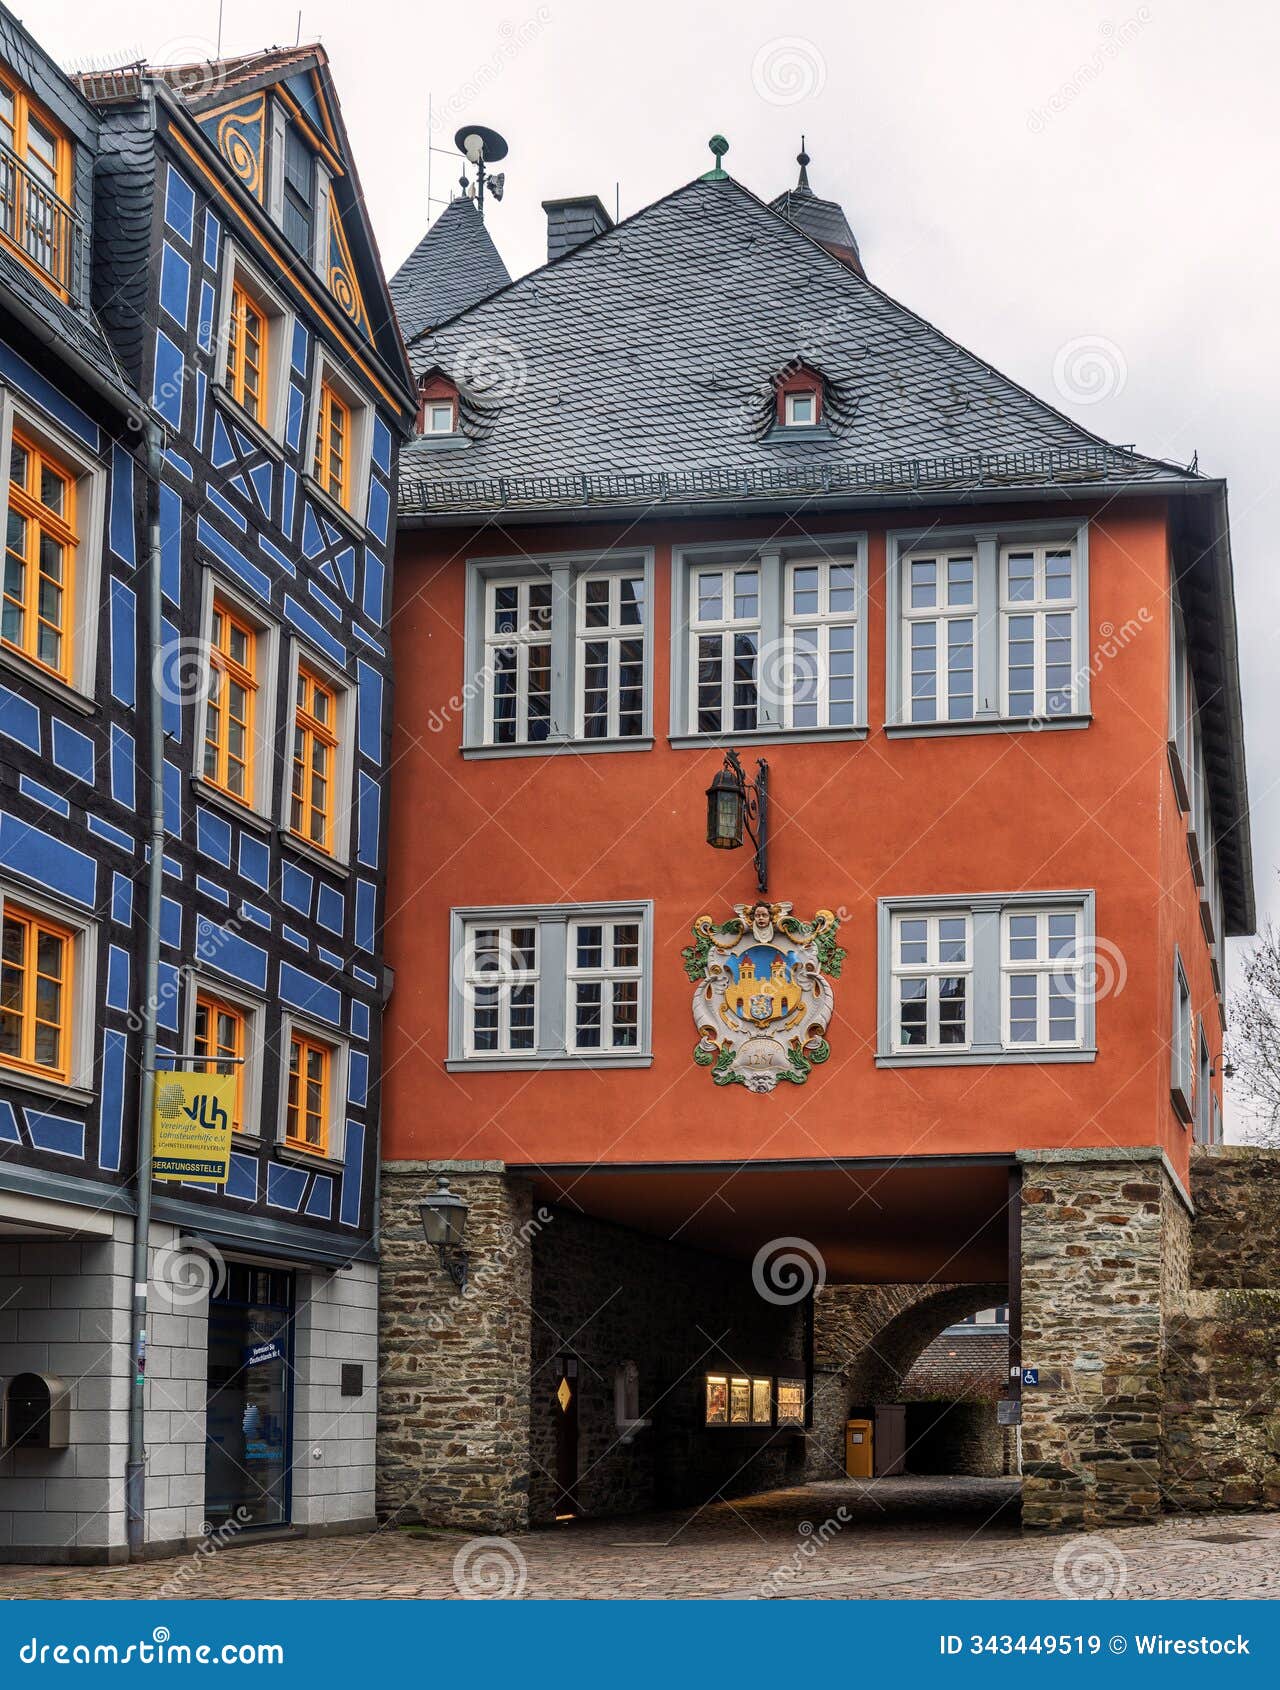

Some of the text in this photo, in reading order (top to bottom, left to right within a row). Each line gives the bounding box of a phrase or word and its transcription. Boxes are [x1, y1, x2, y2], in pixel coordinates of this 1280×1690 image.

[160, 1121, 197, 1132] Vereinigte
[159, 1131, 212, 1142] Lohnsteuerhilfe
[152, 1161, 222, 1174] BERATUNGSSTELLE
